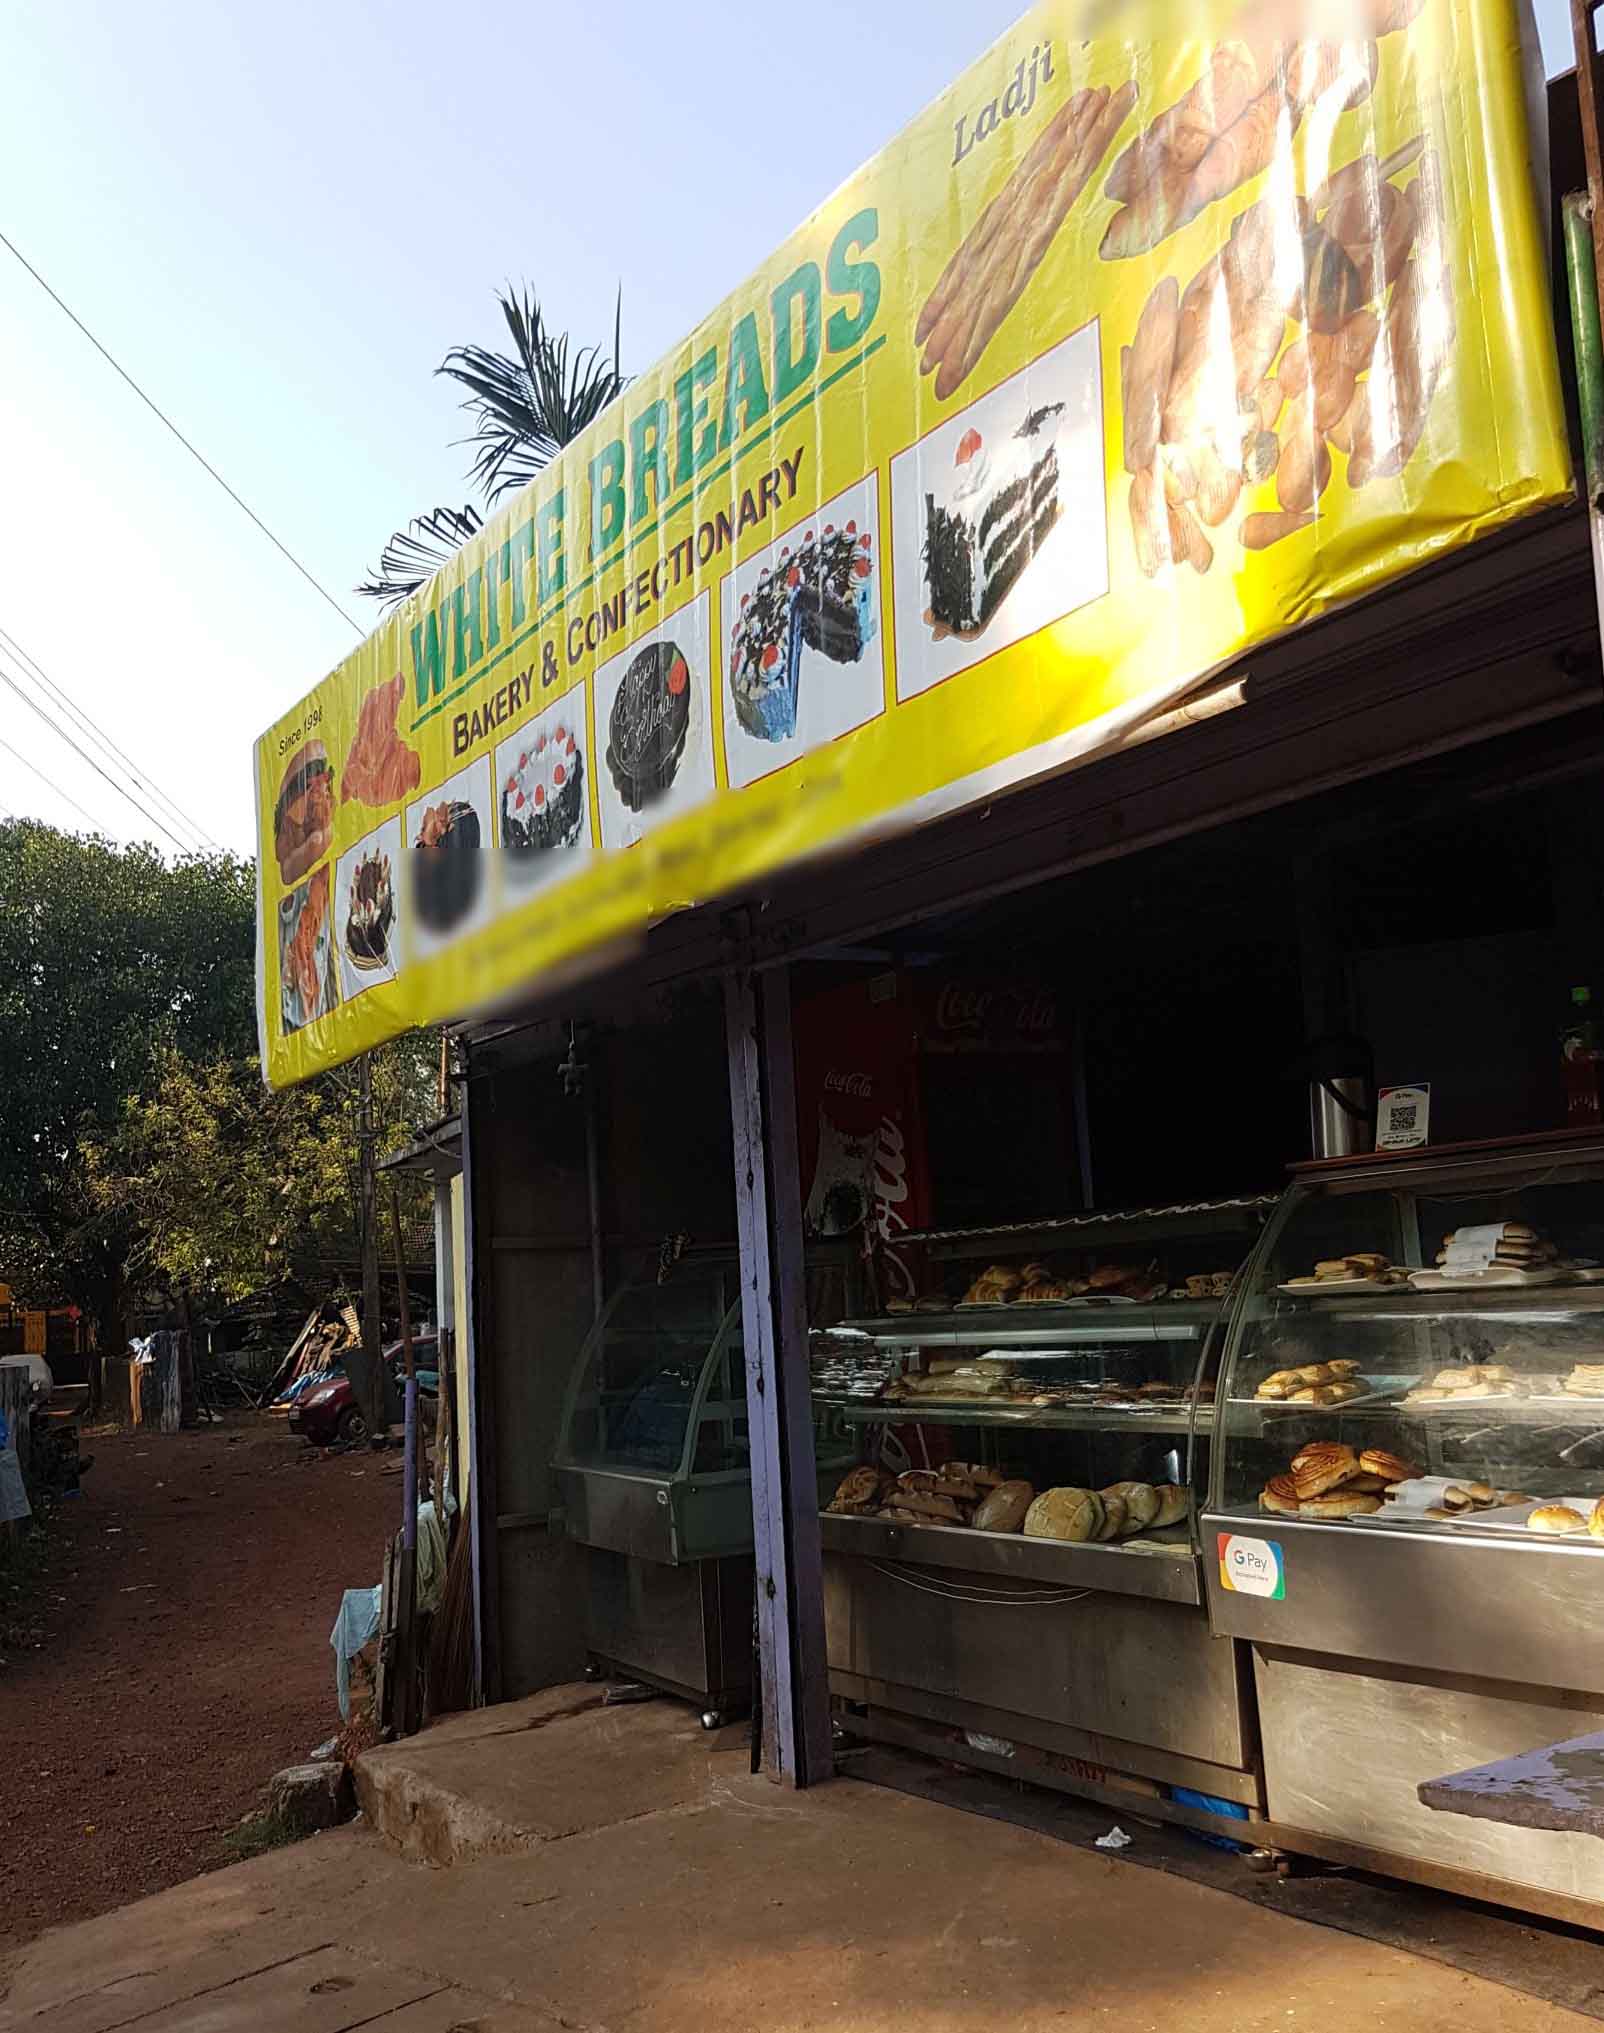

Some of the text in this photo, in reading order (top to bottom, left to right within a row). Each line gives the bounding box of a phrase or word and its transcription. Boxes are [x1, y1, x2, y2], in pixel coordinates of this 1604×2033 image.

[951, 40, 1055, 168] Ladji
[410, 206, 882, 708] WHITE BREADS
[453, 446, 805, 758] BAKERY & CONFECTIONARY
[279, 728, 302, 756] Since
[1233, 1549, 1268, 1573] G Pay
